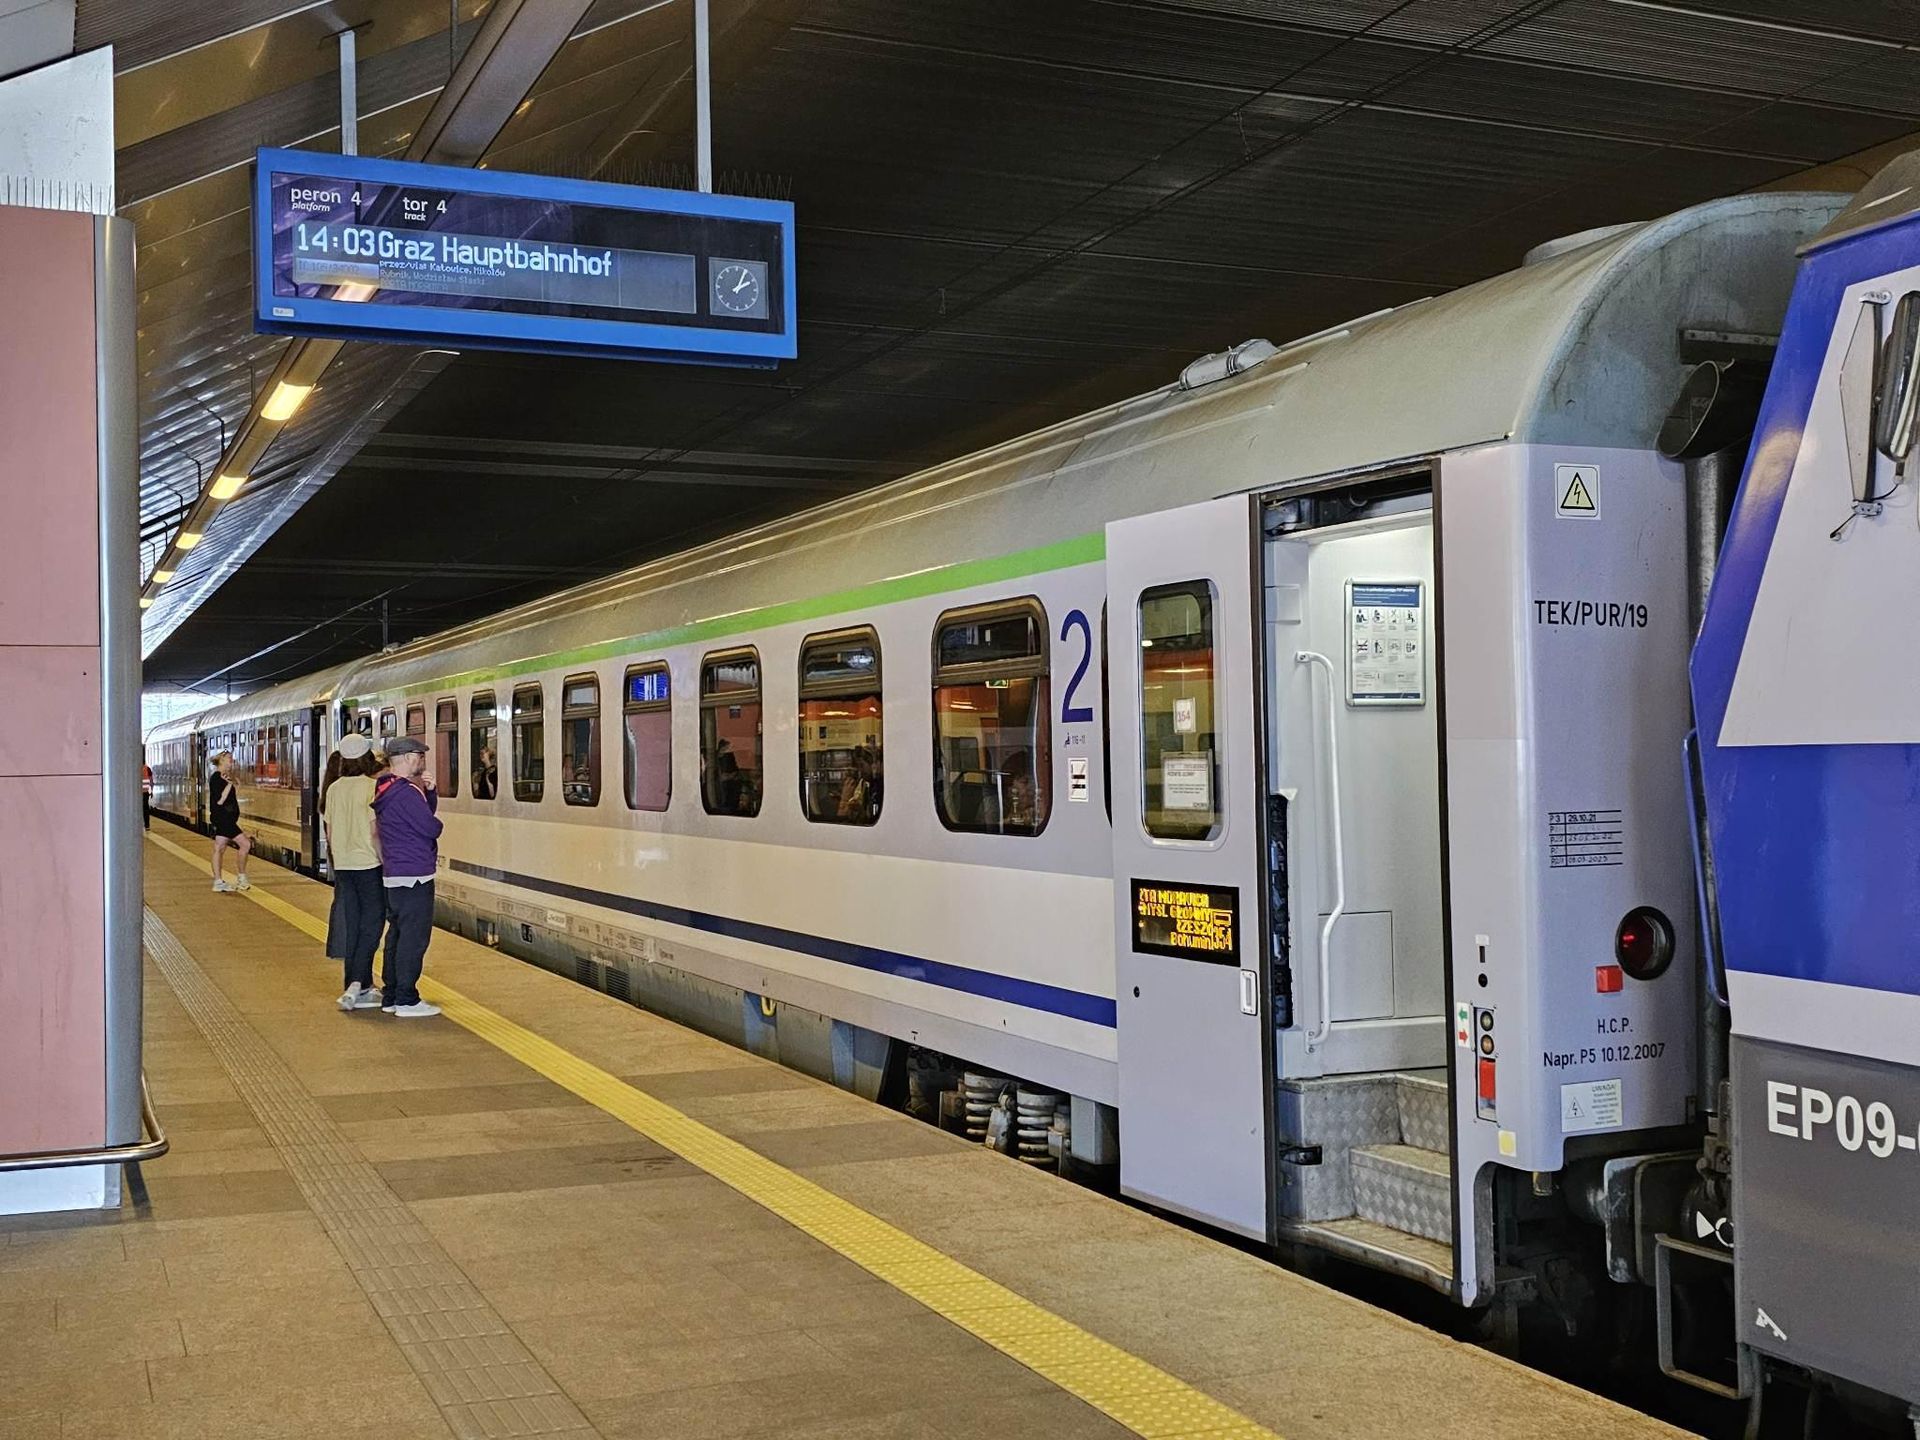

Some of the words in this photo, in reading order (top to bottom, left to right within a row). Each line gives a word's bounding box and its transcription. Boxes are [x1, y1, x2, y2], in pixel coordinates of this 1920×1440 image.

[290, 187, 341, 203] peron
[351, 191, 362, 206] 4
[402, 197, 428, 212] tor
[436, 200, 448, 213] 4
[291, 202, 331, 212] platform
[404, 212, 427, 222] track
[298, 223, 375, 257] 14:03
[378, 230, 435, 262] Graz
[442, 236, 612, 277] Hauptbahnhof
[429, 262, 472, 275] Katowice,
[1534, 599, 1648, 628] TEK/PUR/19
[1060, 609, 1093, 723] 2
[1597, 1017, 1634, 1034] H.C.P.
[1543, 1051, 1577, 1069] Napr.
[1580, 1048, 1596, 1064] P5
[1601, 1042, 1666, 1062] 10.12.2007
[1767, 1080, 1920, 1158] EP09-
